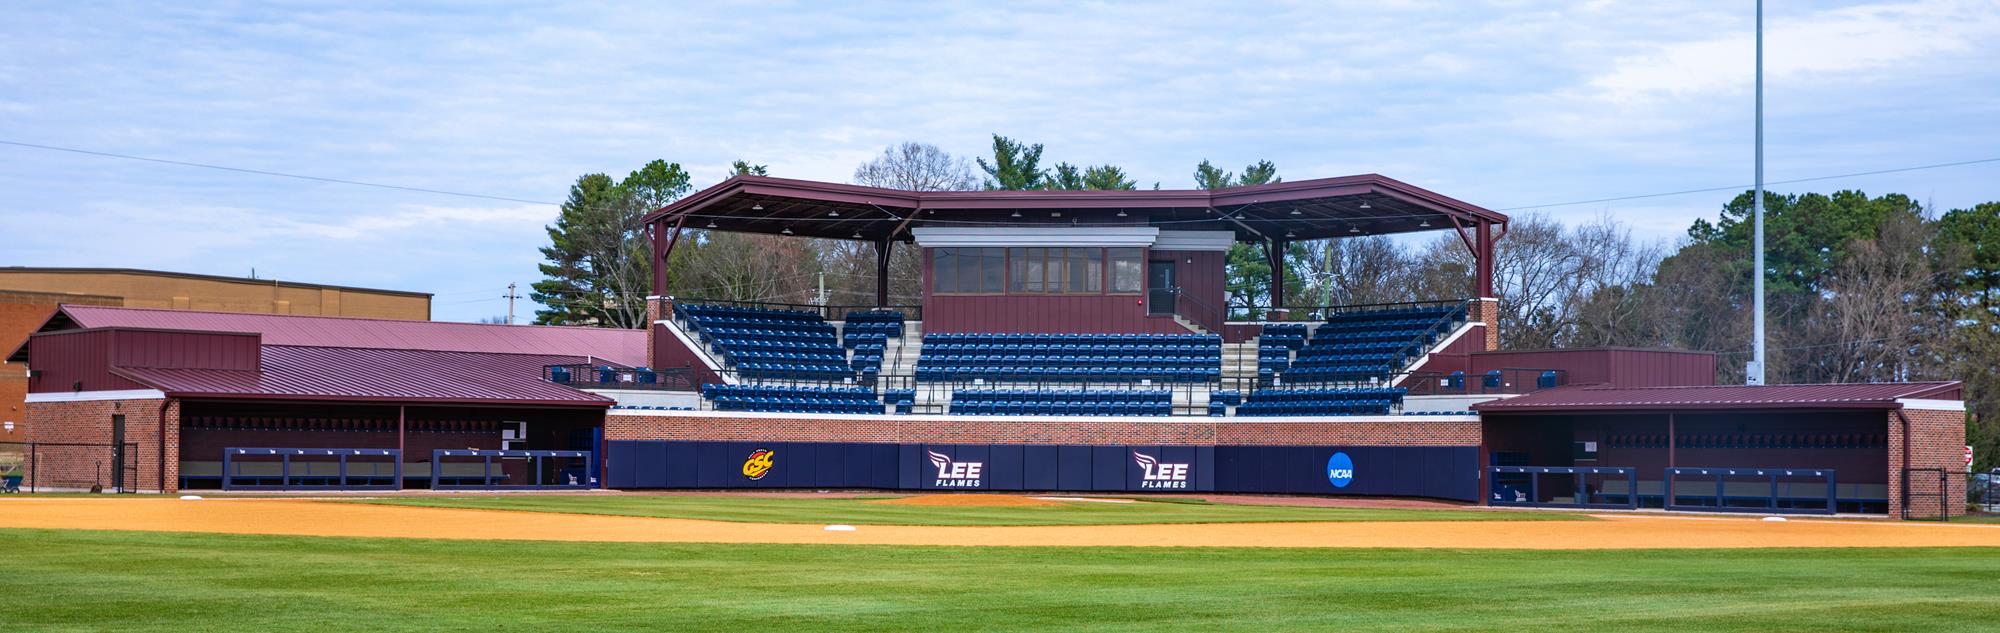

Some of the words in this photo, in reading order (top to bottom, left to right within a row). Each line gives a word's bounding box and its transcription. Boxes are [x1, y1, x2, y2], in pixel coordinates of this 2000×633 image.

[743, 450, 774, 477] GSC
[938, 462, 982, 478] LEE
[1144, 463, 1189, 480] LEE
[1330, 469, 1352, 478] NCAA
